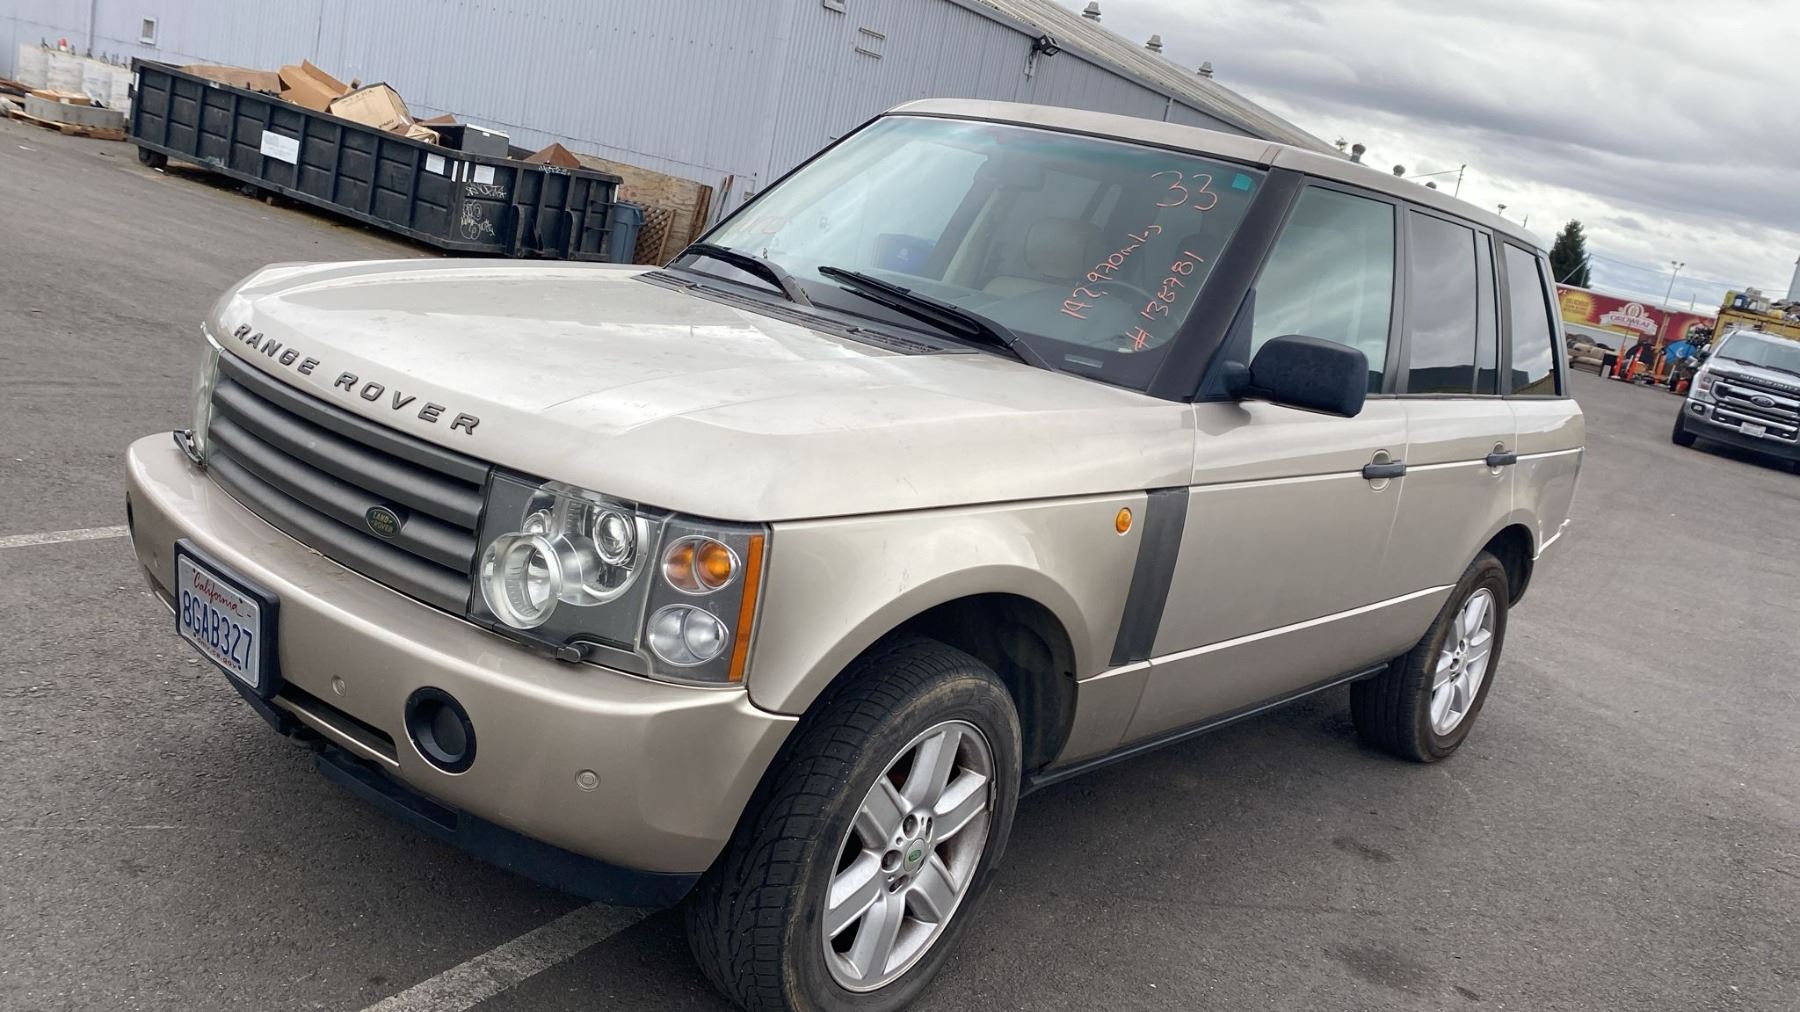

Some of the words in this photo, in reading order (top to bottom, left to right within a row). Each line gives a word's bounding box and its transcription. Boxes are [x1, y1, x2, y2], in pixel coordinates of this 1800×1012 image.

[1151, 170, 1218, 212] 33
[233, 322, 321, 376] RANGE
[333, 371, 481, 436] ROVER
[193, 571, 244, 617] California
[182, 589, 253, 670] 8GAB327
